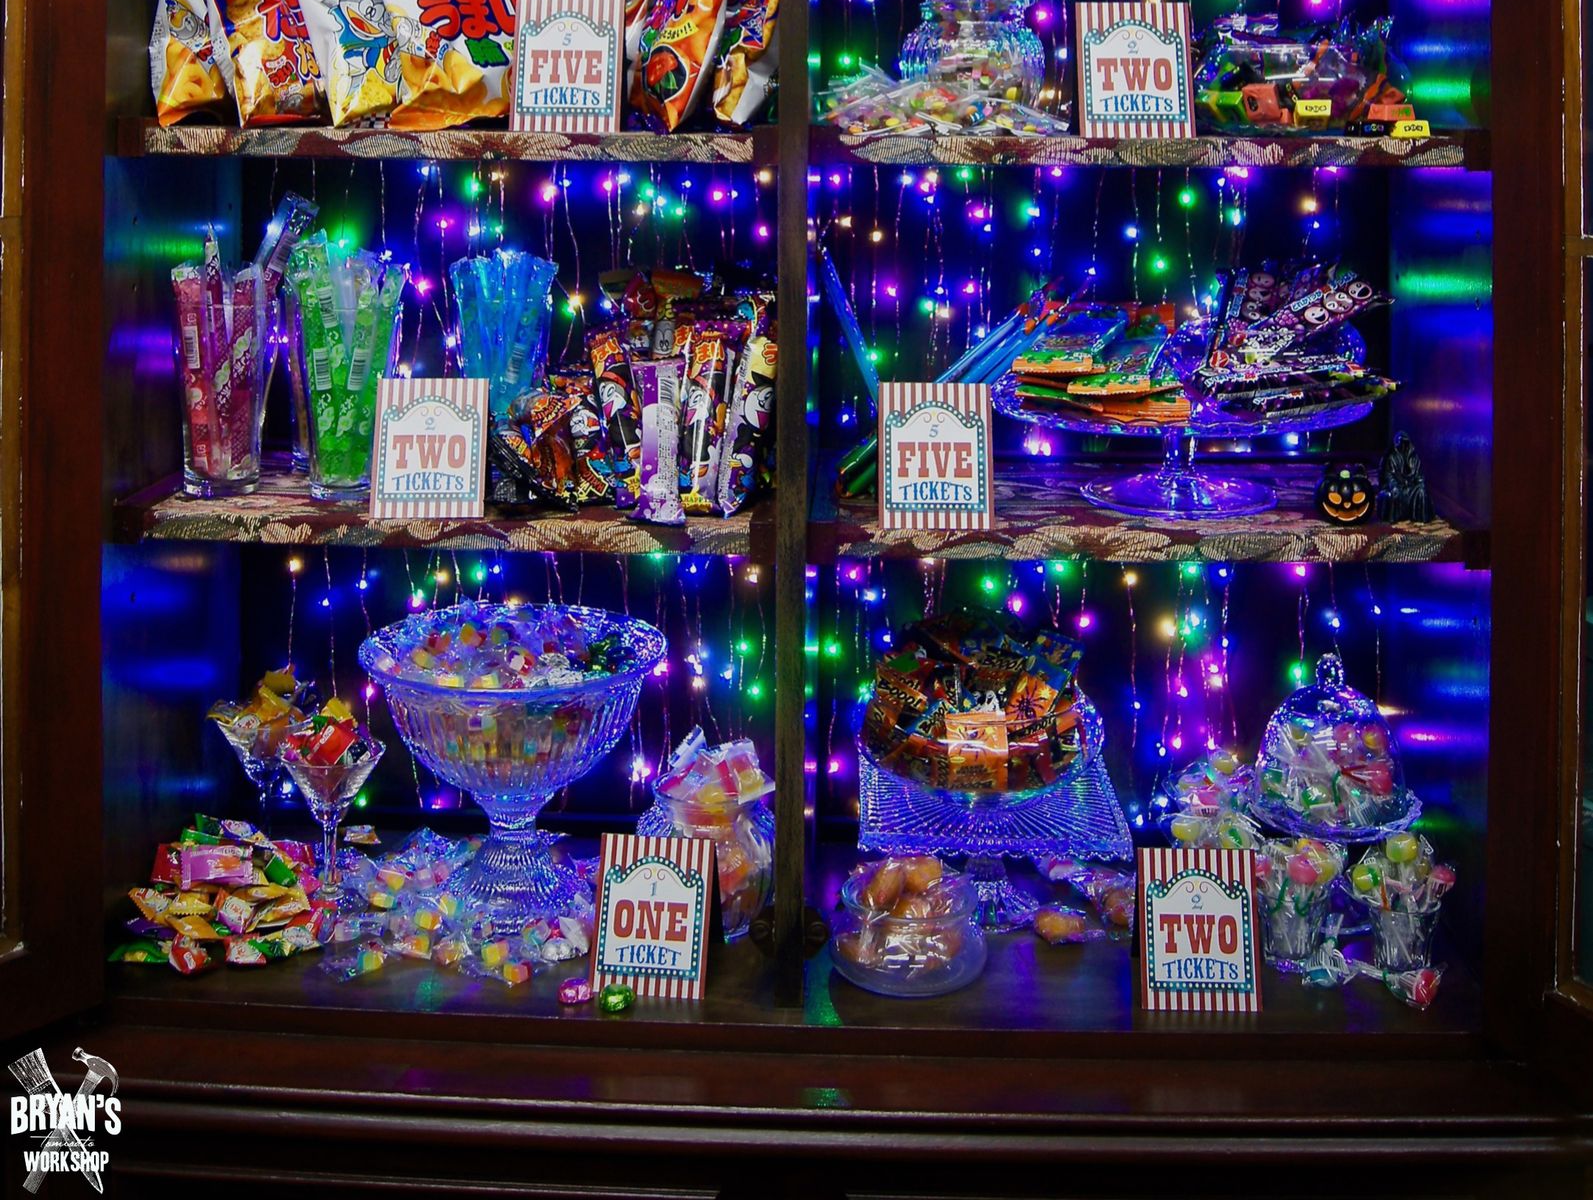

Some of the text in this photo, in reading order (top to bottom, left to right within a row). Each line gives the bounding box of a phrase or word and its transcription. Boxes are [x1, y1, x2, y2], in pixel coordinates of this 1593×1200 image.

[561, 33, 572, 46] 5
[1127, 41, 1139, 54] 2
[529, 50, 602, 84] FIVE
[1097, 57, 1173, 91] TWO
[529, 86, 601, 106] TICKETS
[1099, 94, 1173, 113] TICKETS
[424, 417, 436, 431] 2
[928, 424, 939, 438] 5
[392, 434, 466, 470] TWO
[898, 442, 972, 478] FIVE
[392, 471, 464, 492] TICKETS
[898, 481, 972, 502] TICKETS
[1191, 895, 1203, 910] 2
[613, 899, 688, 943] ONE
[1159, 913, 1239, 955] TWO
[616, 945, 682, 967] TICKET
[1162, 958, 1239, 981] TICKETS
